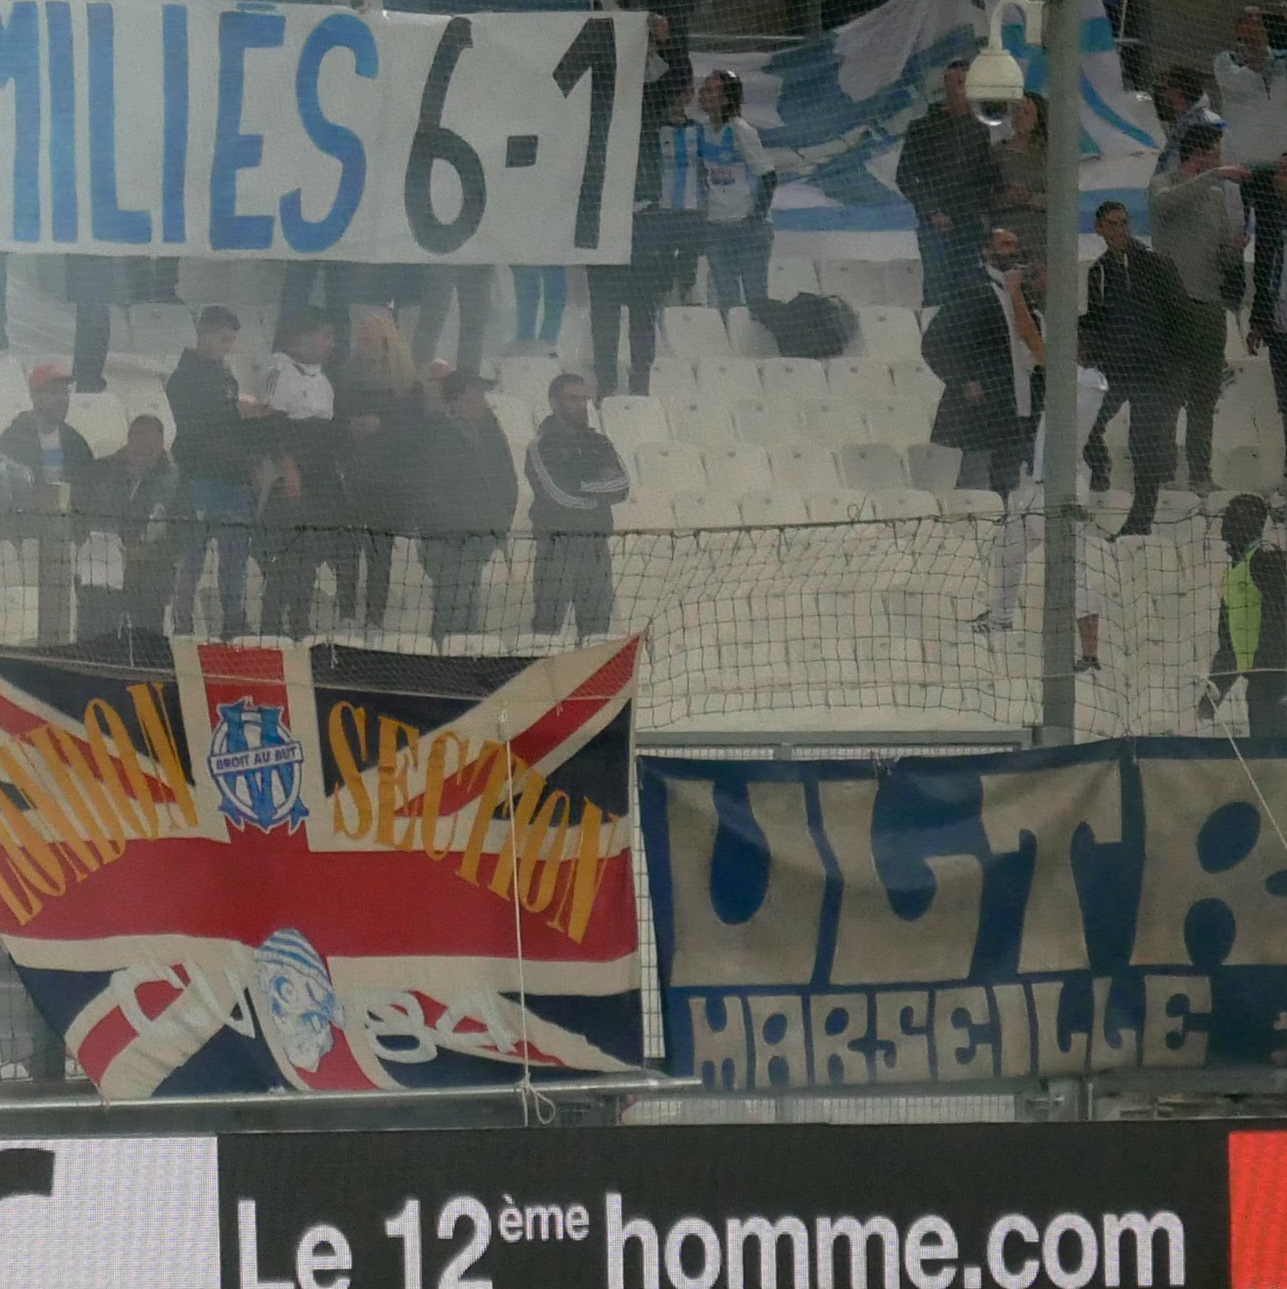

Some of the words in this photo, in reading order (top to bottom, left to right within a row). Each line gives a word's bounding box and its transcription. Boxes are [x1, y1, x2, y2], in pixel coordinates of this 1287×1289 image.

[404, 15, 618, 254] 6-1
[255, 751, 271, 764] AU
[330, 700, 622, 945] SECTION
[688, 974, 1213, 1091] MARSEILLE
[237, 1198, 353, 1289] Le
[605, 1192, 1186, 1289] homme.com
